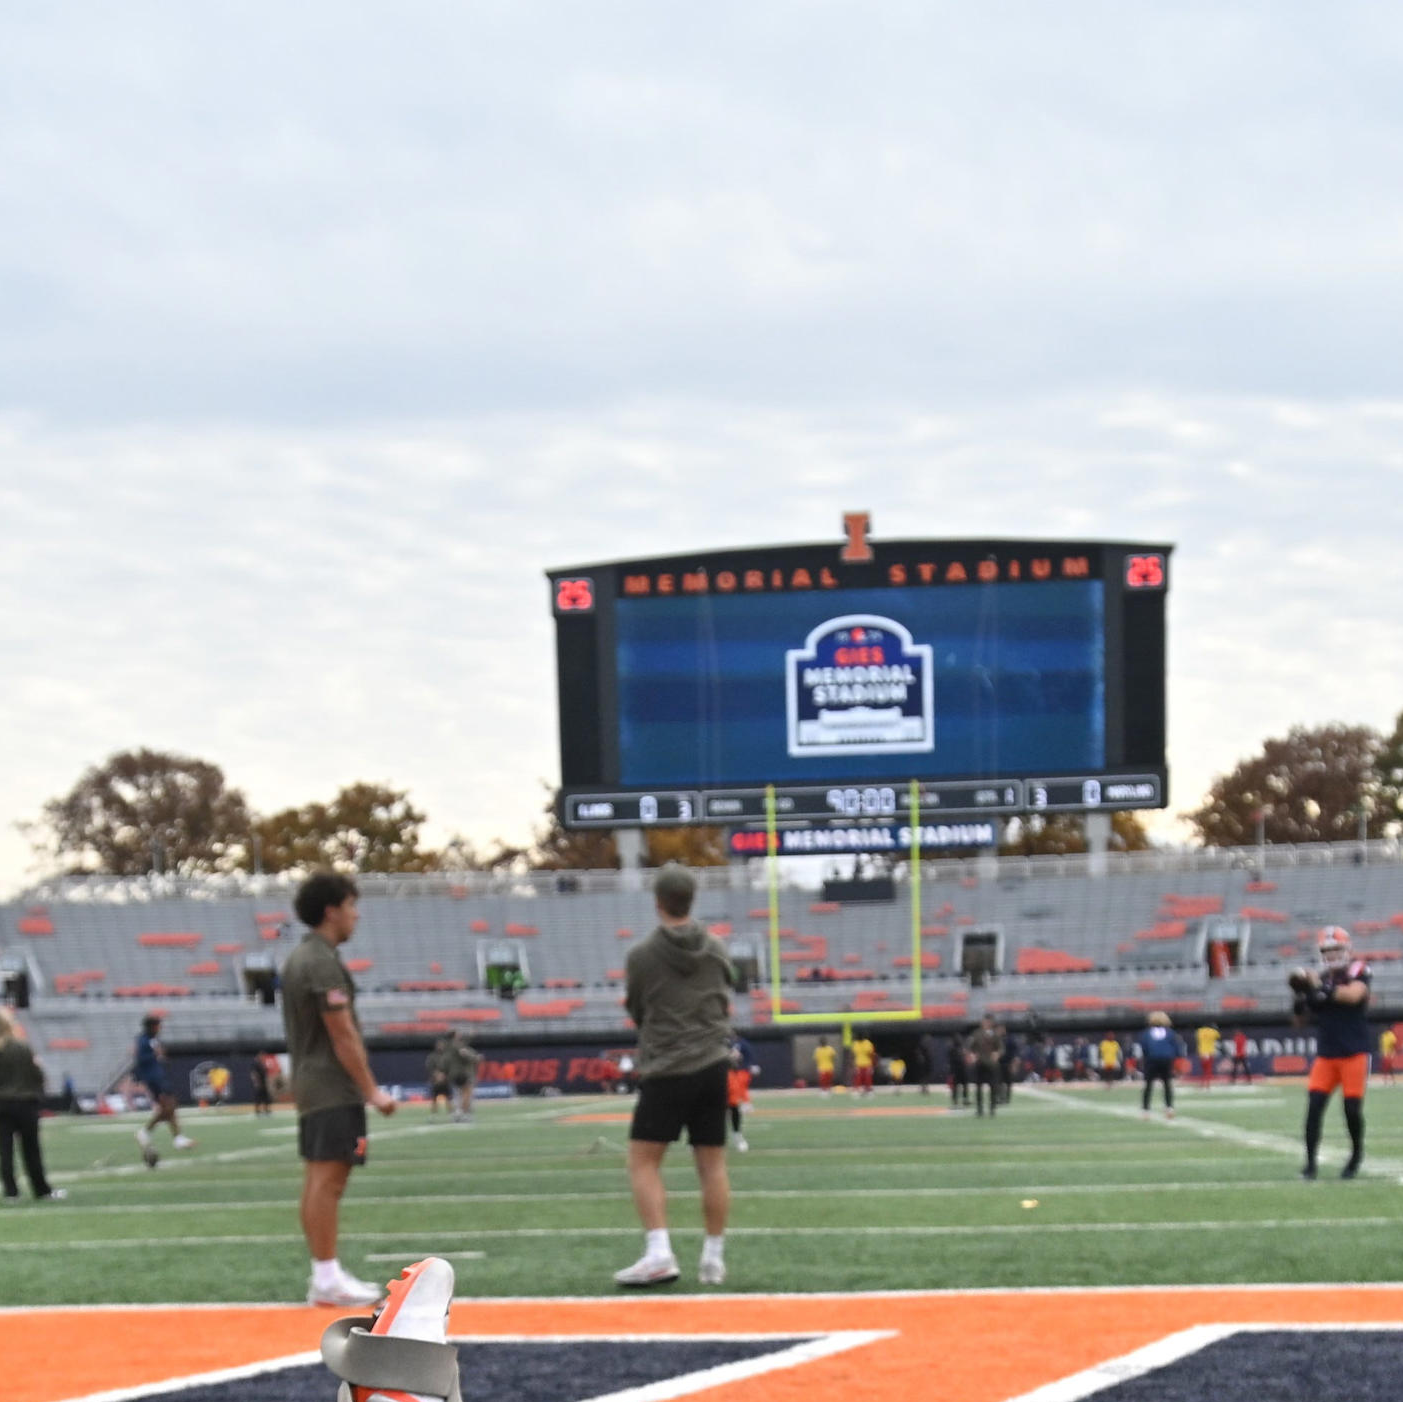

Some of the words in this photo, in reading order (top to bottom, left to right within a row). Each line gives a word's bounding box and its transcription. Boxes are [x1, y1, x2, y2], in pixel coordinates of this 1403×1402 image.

[623, 566, 839, 595] MEMORIAL
[888, 556, 1090, 585] STADIUM
[834, 646, 885, 665] GIES
[803, 664, 917, 687] MEMORIAL
[812, 683, 908, 706] STADIUM
[783, 827, 896, 850] MEMORIAL
